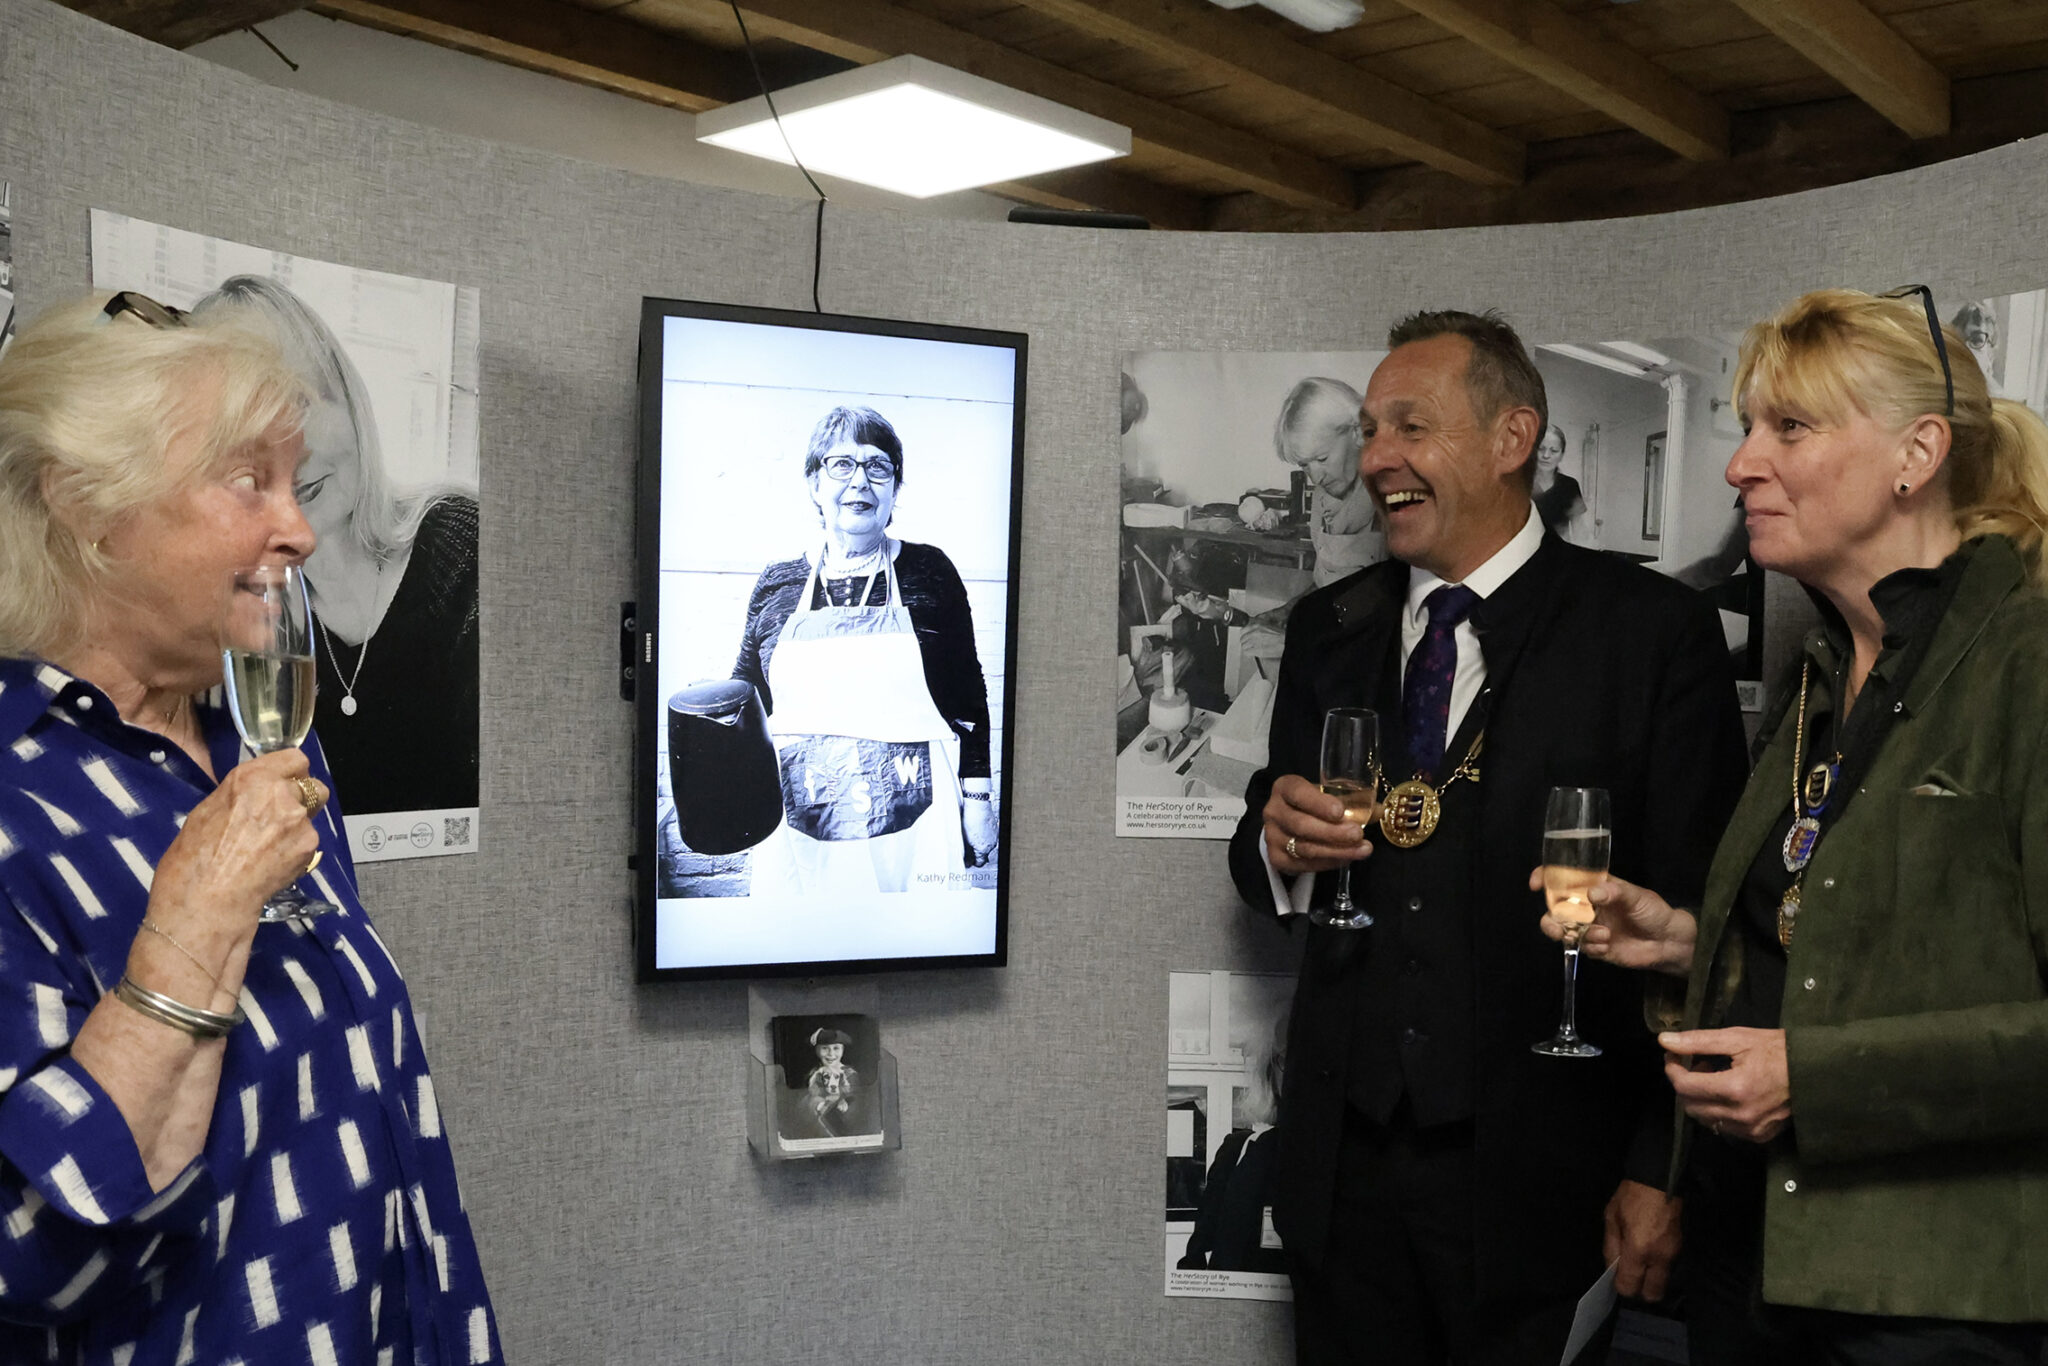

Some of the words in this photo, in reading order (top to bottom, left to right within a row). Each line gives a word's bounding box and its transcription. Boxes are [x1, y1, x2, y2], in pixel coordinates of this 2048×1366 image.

[1127, 801, 1144, 810] The
[1145, 801, 1184, 813] HerStory
[1185, 803, 1195, 811] of
[1196, 802, 1213, 814] Rye
[1133, 812, 1173, 820] celebration
[1174, 812, 1182, 820] of
[1210, 813, 1240, 823] working
[1127, 821, 1207, 831] www.herstoryrye.co.uk
[916, 872, 946, 884] Kathy
[948, 872, 991, 882] Redman
